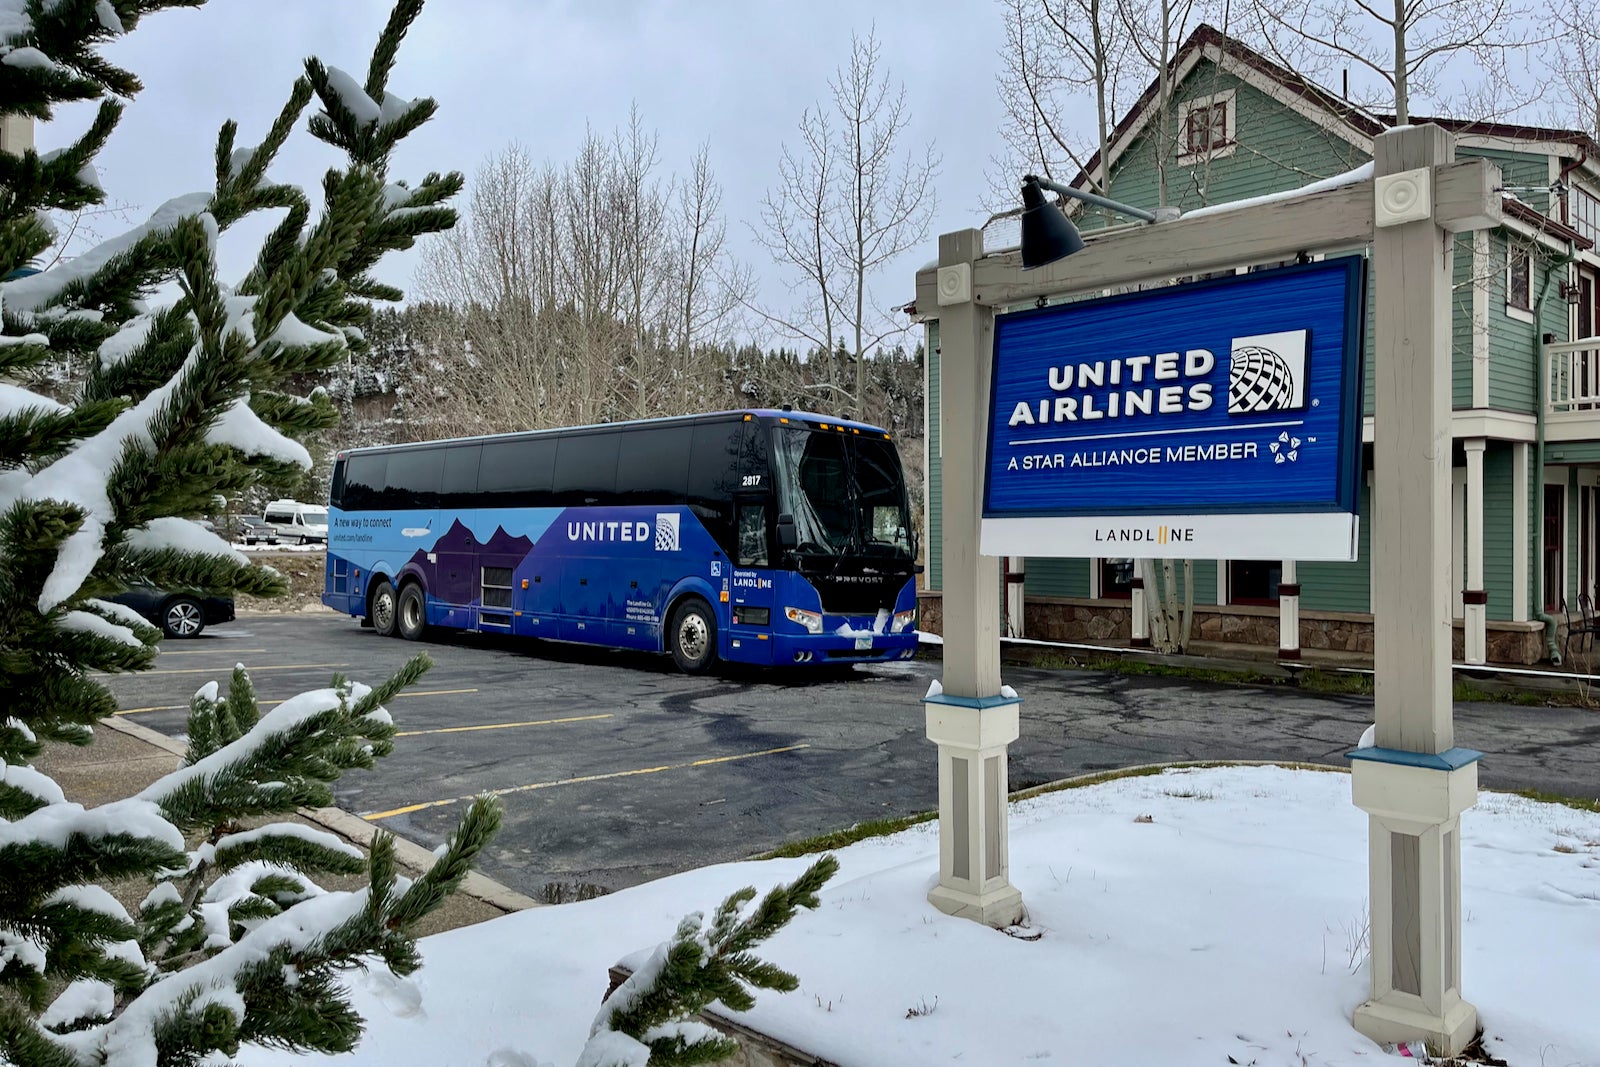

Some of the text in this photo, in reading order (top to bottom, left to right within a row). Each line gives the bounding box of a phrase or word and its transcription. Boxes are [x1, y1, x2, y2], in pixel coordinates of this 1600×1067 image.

[1048, 348, 1215, 391] UNITED
[1008, 383, 1214, 427] AIRLINES
[1007, 442, 1258, 471] A STAR ALLIANCE MEMBER
[742, 475, 761, 486] 2817
[335, 517, 392, 529] A new way to connect
[568, 522, 650, 541] UNITED
[1095, 525, 1195, 544] LANDLINE
[734, 578, 772, 589] LANDLINE
